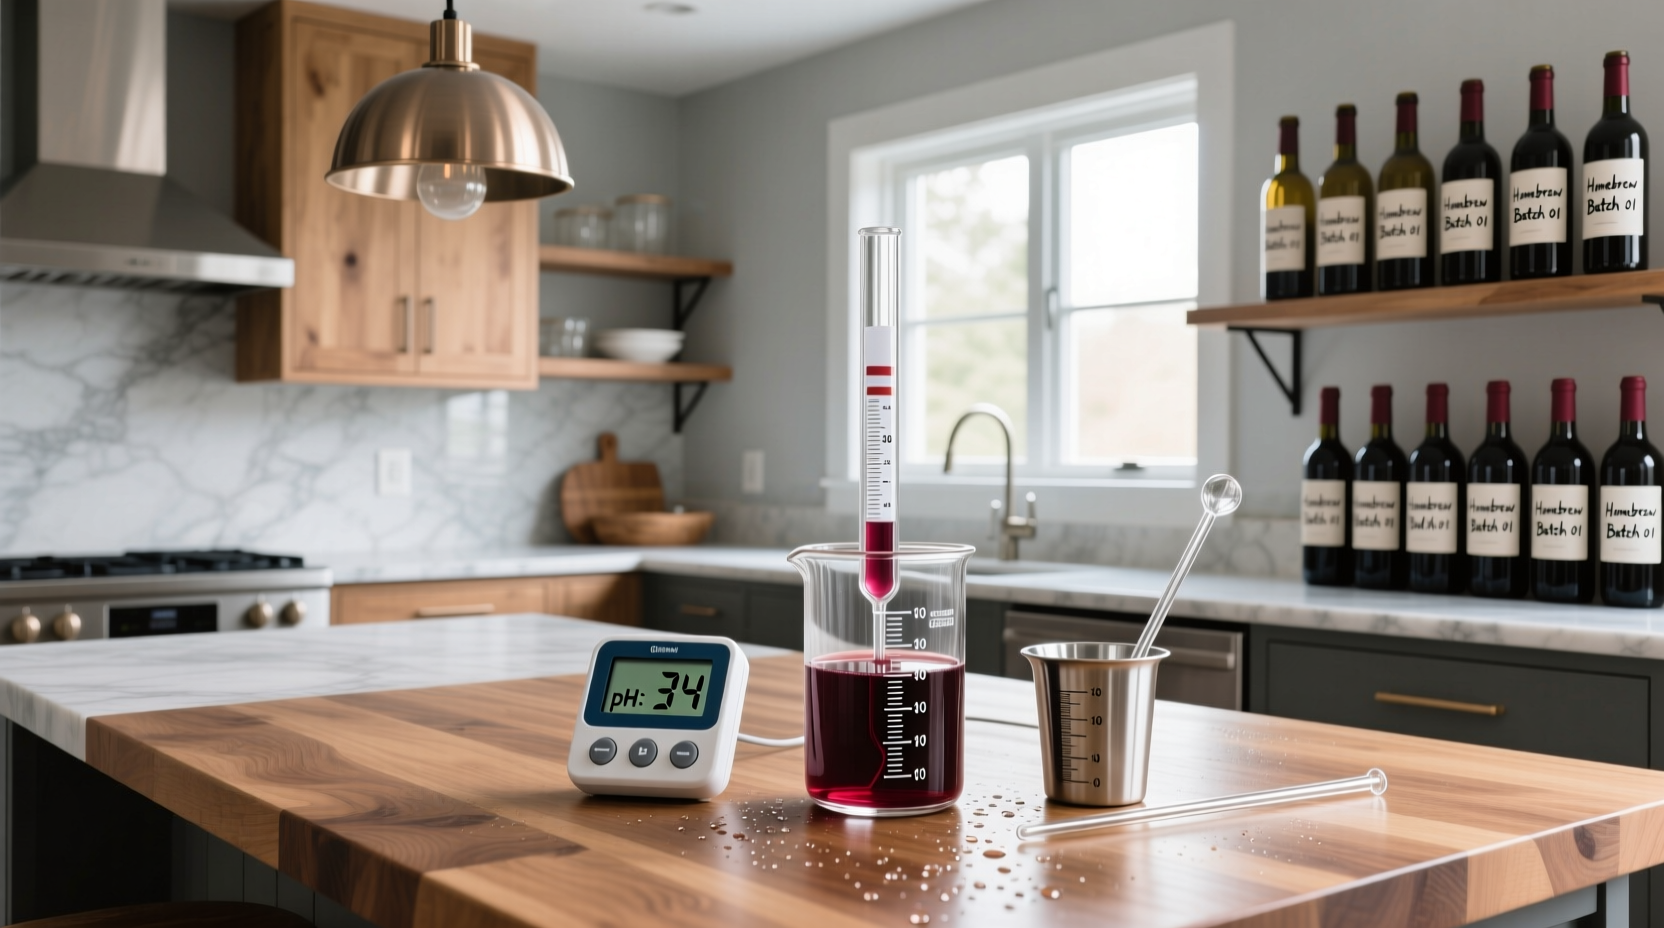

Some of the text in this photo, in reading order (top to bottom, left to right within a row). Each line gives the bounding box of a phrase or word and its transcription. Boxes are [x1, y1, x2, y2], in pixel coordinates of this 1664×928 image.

[1587, 174, 1638, 193] Homebrew
[1587, 196, 1636, 215] Batch 01
[1513, 205, 1561, 223] Batch 01
[1410, 225, 1420, 236] 01
[1444, 214, 1488, 231] Batch 01
[1470, 518, 1513, 533] Batch 01
[1536, 521, 1582, 537] Batch 01
[1606, 523, 1655, 539] Batch 01
[609, 671, 704, 712] pH: 34
[1091, 687, 1102, 697] 10
[1091, 716, 1102, 726] 10
[1093, 778, 1100, 787] 0
